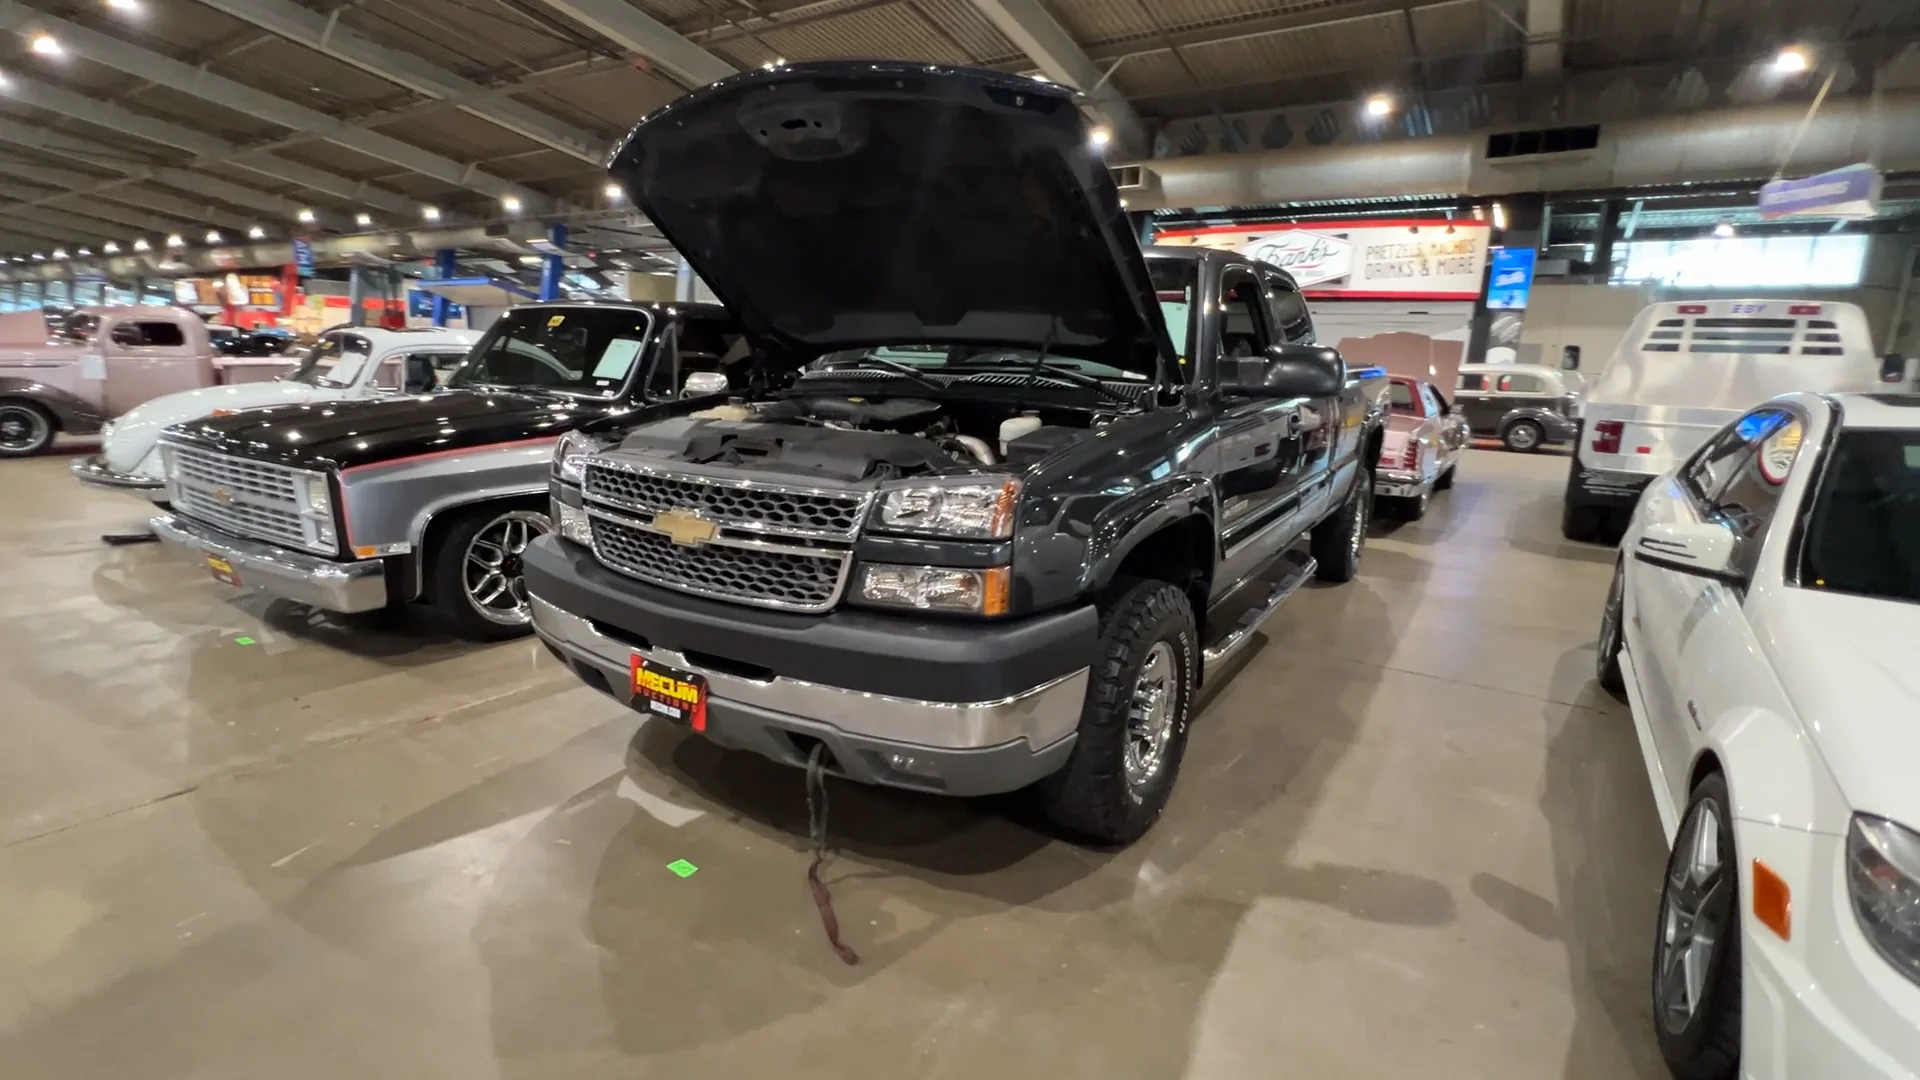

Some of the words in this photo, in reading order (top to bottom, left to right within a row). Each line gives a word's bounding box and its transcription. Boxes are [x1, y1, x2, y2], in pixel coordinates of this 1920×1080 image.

[1256, 238, 1340, 267] Frank's
[1364, 260, 1415, 280] DRINKS
[1420, 257, 1430, 277] &
[1436, 255, 1474, 276] MORE
[636, 667, 698, 704] MECUM
